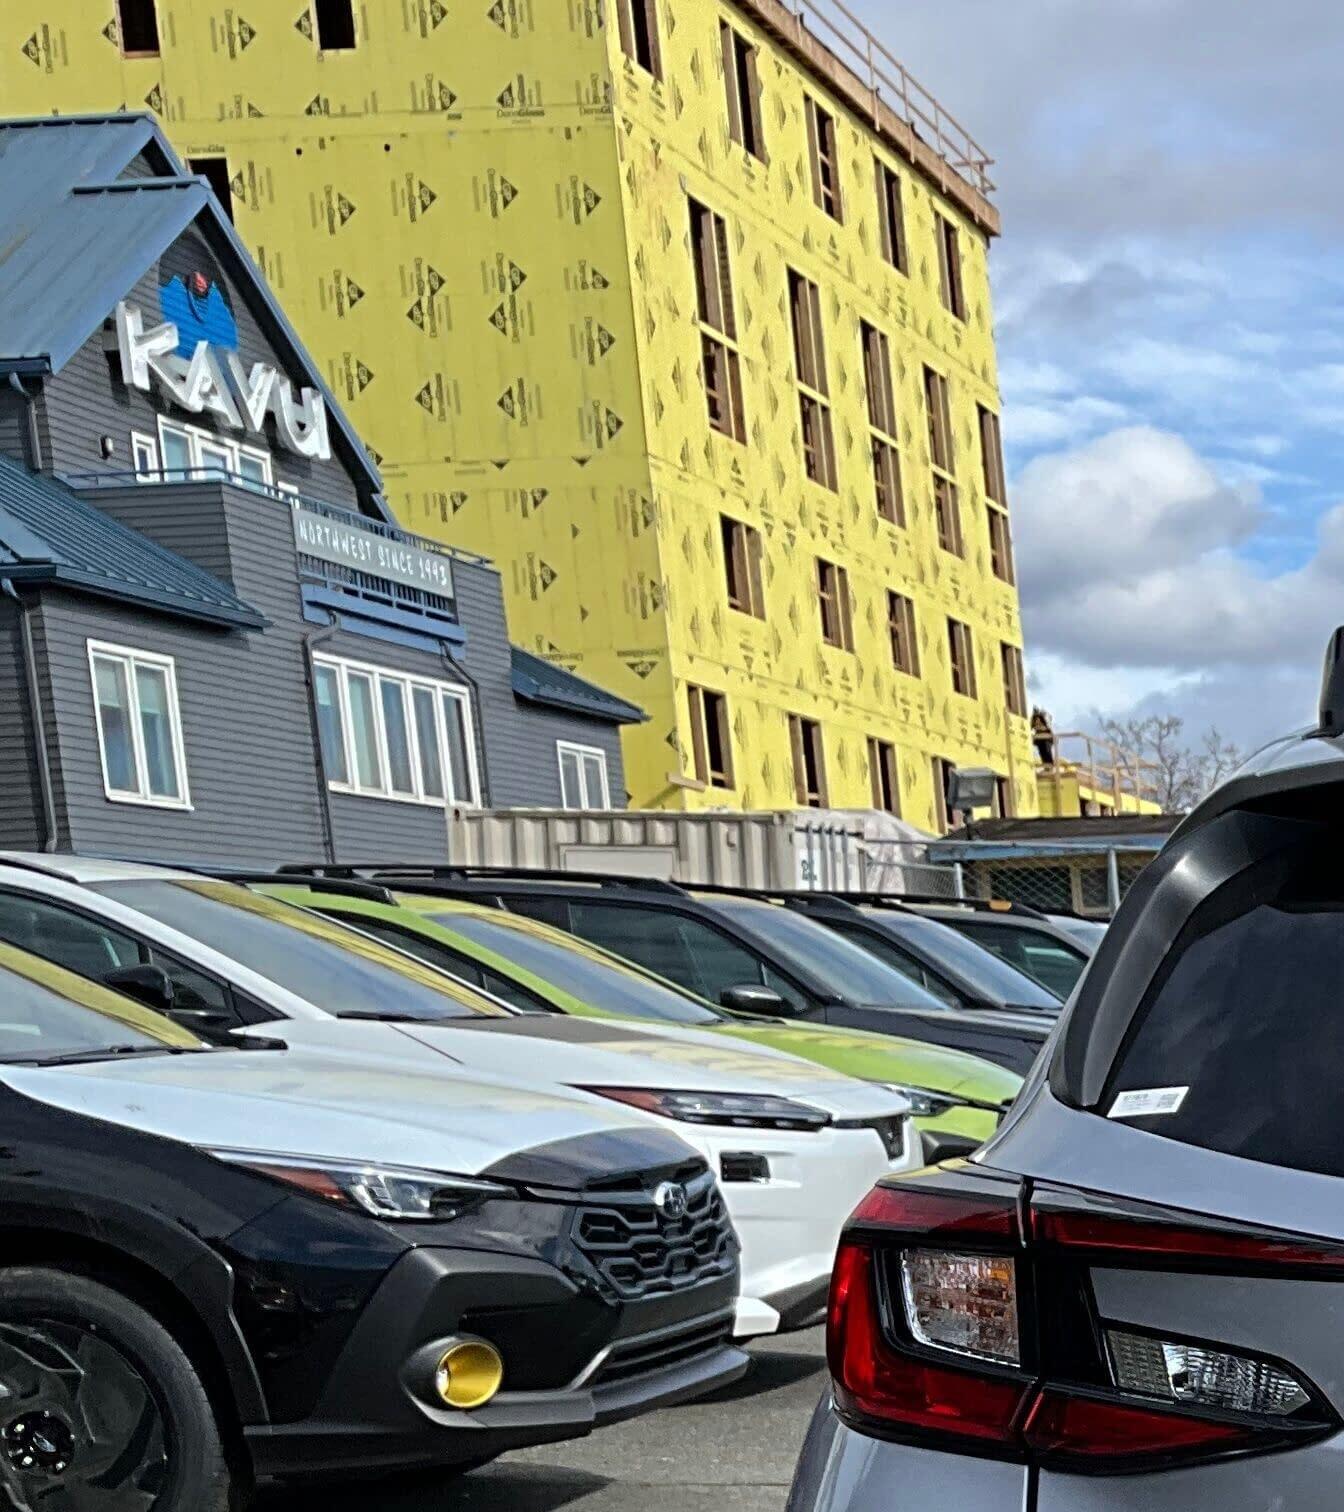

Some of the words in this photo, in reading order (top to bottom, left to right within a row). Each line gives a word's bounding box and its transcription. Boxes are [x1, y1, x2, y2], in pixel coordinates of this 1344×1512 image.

[116, 301, 331, 460] KAVU
[299, 521, 371, 561] NORTHWEST
[377, 545, 414, 575] SINCE
[418, 557, 448, 586] 1993
